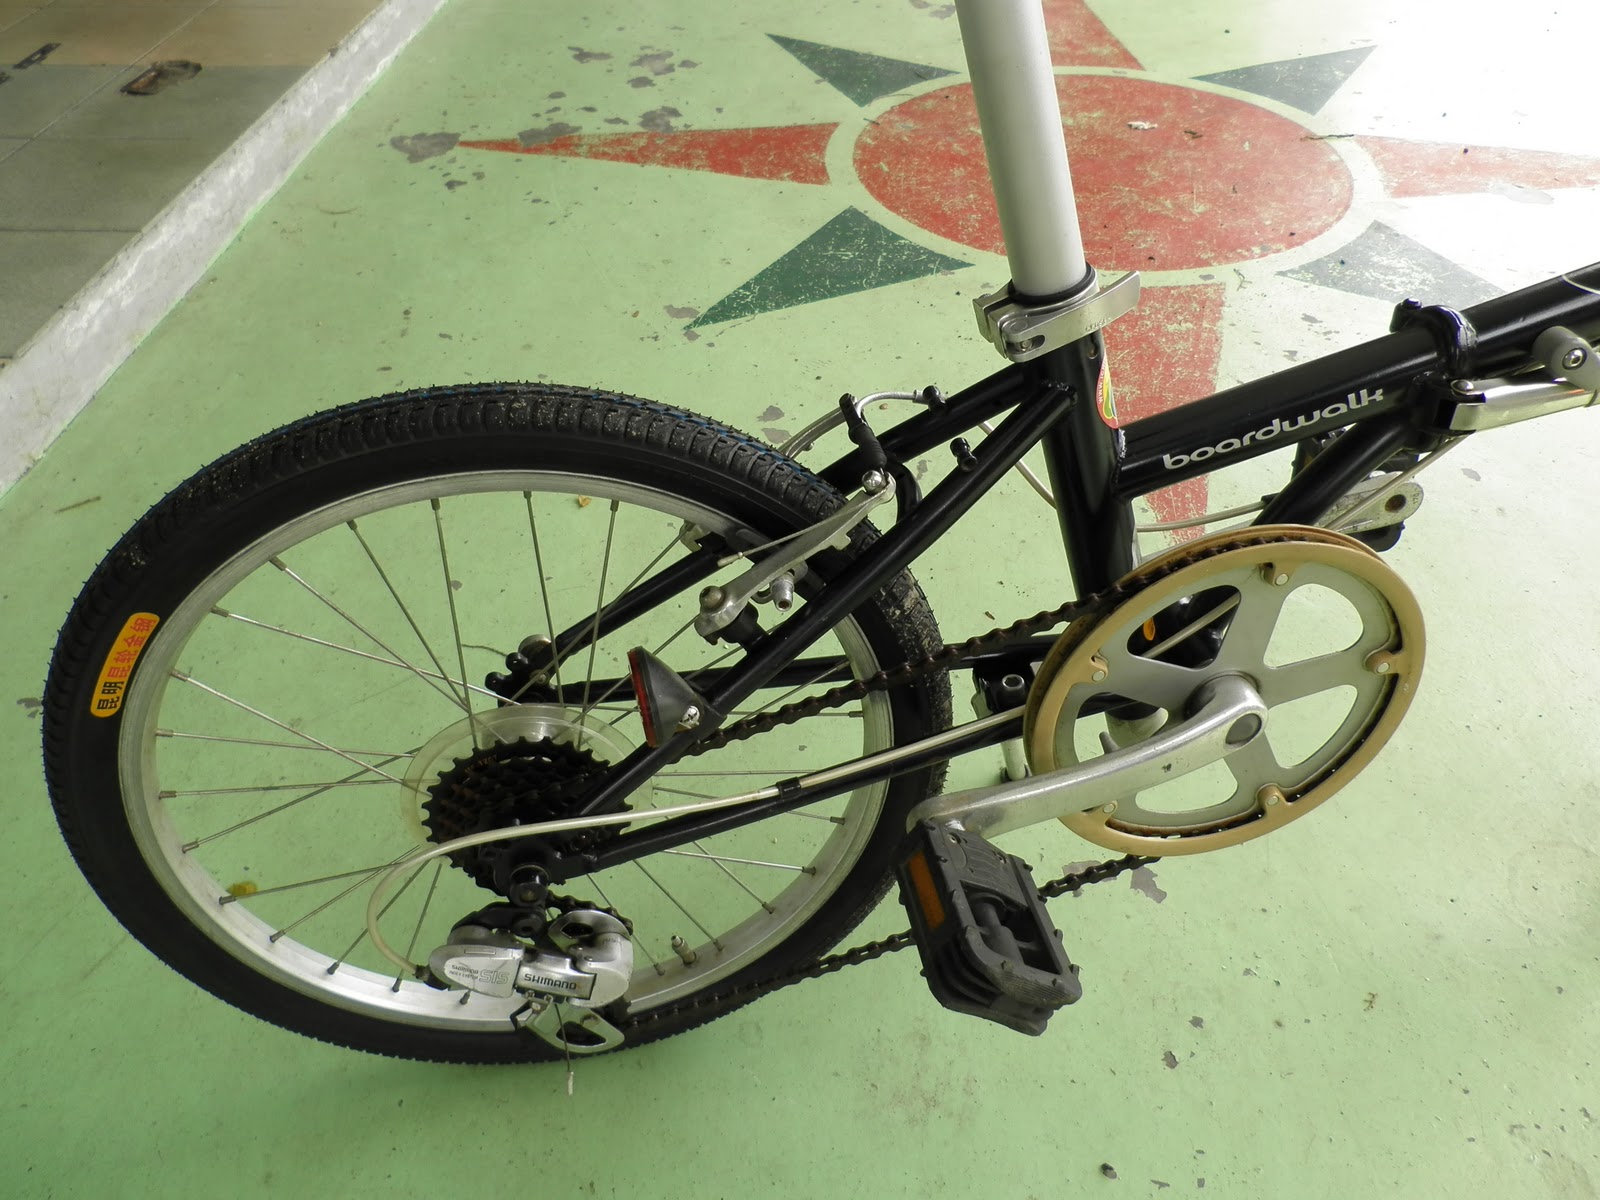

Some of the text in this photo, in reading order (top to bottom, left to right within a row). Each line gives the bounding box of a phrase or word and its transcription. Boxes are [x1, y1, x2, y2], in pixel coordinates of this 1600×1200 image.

[1162, 387, 1384, 470] boardwalk
[479, 969, 510, 985] SIS
[524, 973, 578, 990] SHIMANO
